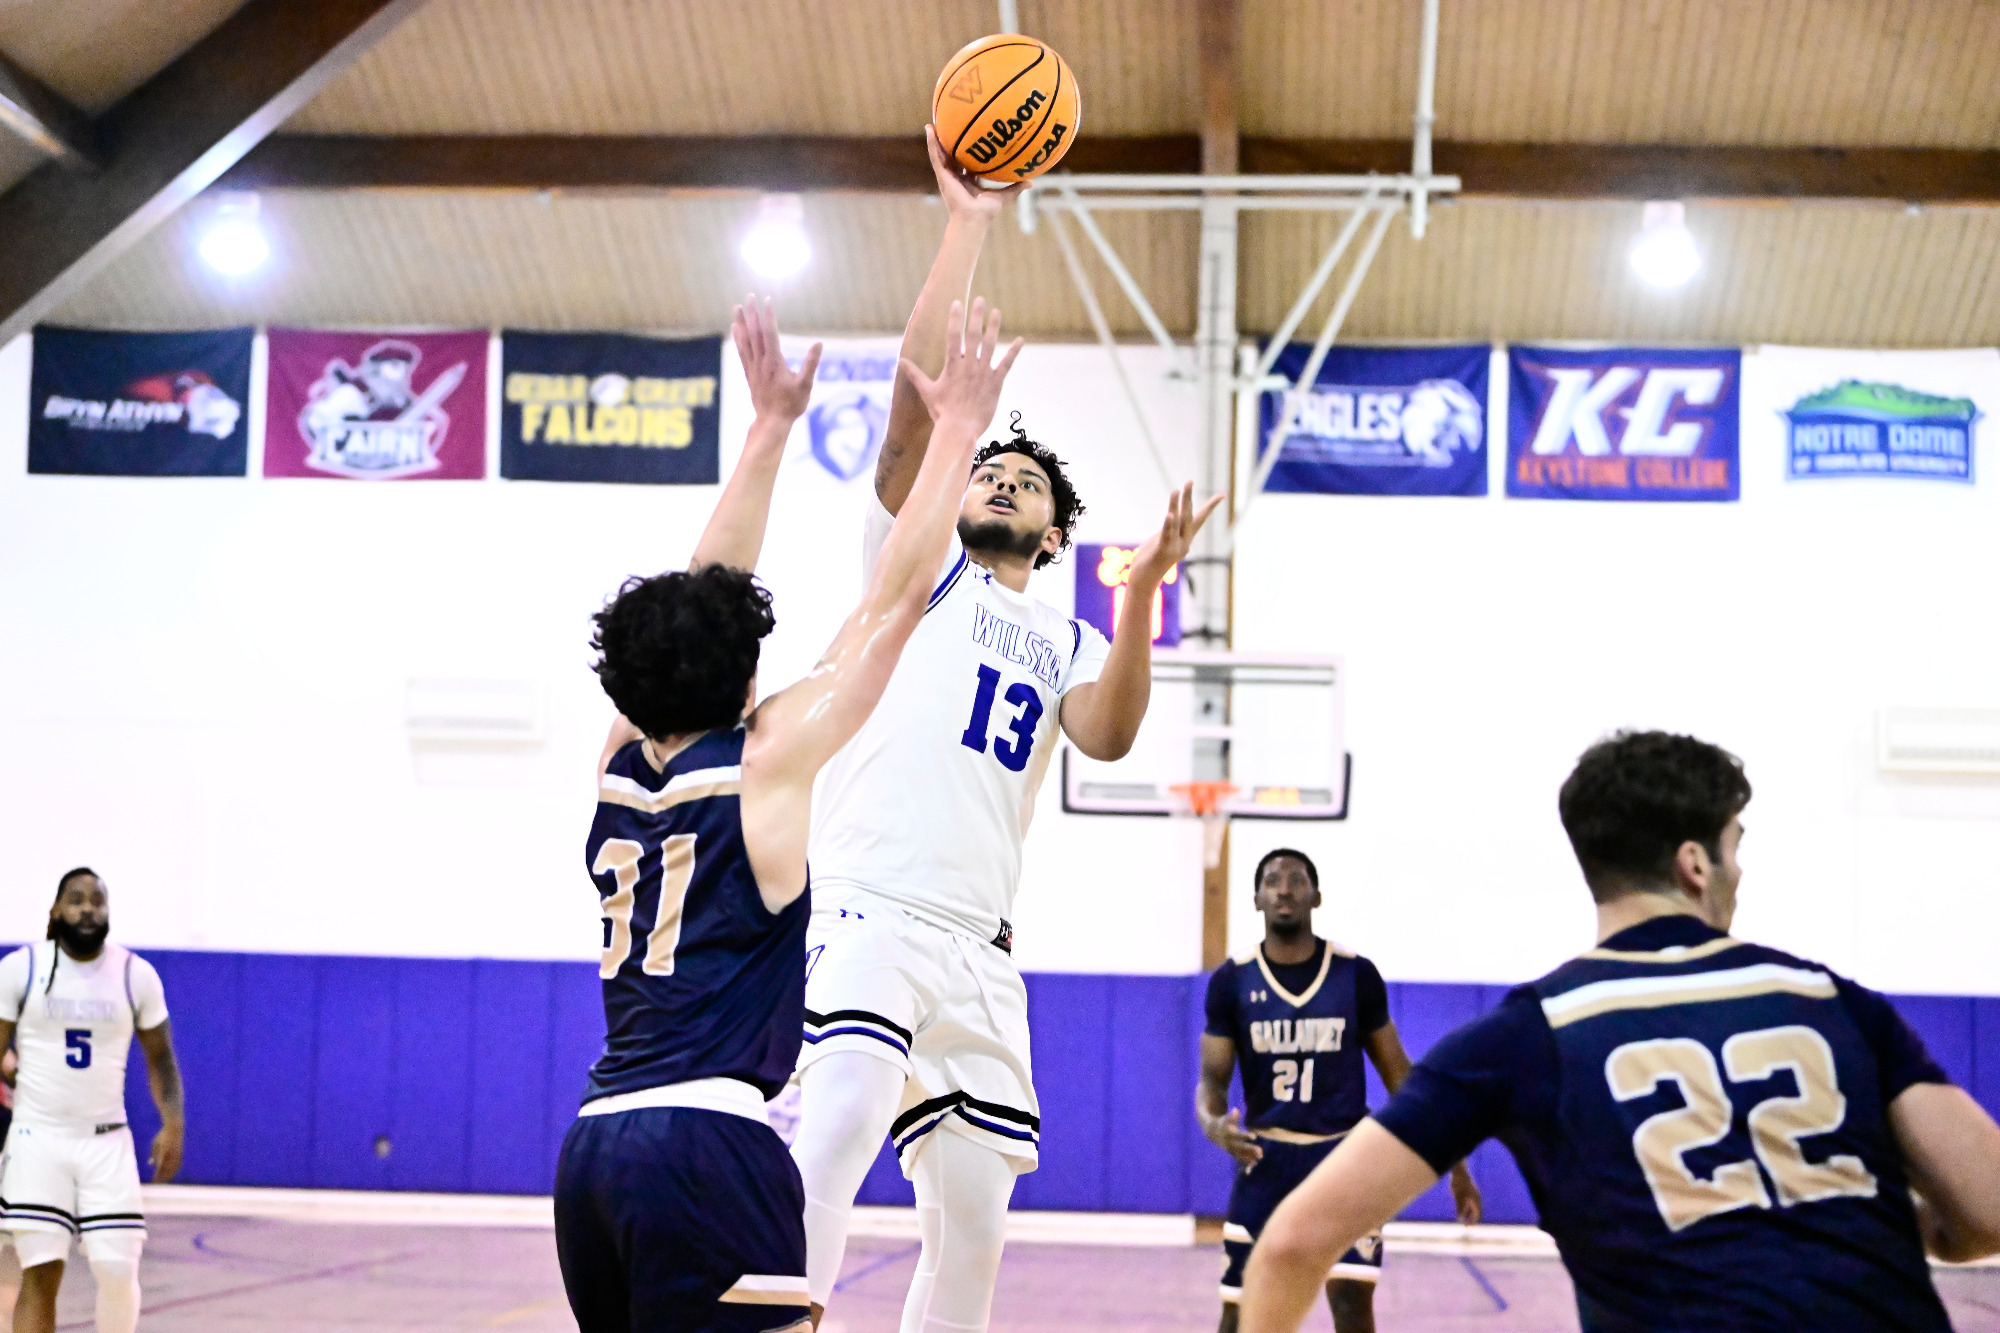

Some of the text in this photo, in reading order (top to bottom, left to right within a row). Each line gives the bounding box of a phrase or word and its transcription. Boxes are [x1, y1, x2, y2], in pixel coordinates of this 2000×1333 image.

[965, 89, 1046, 164] Wilson
[1013, 122, 1067, 177] NCAA
[521, 402, 693, 450] FALCONS
[1532, 367, 1725, 456] KC
[1794, 422, 1968, 457] NOTRE DAME
[961, 662, 1044, 772] 13
[592, 832, 698, 980] 31
[65, 1028, 92, 1069] 5
[1272, 1058, 1315, 1104] 21
[1604, 1025, 1878, 1233] 22
